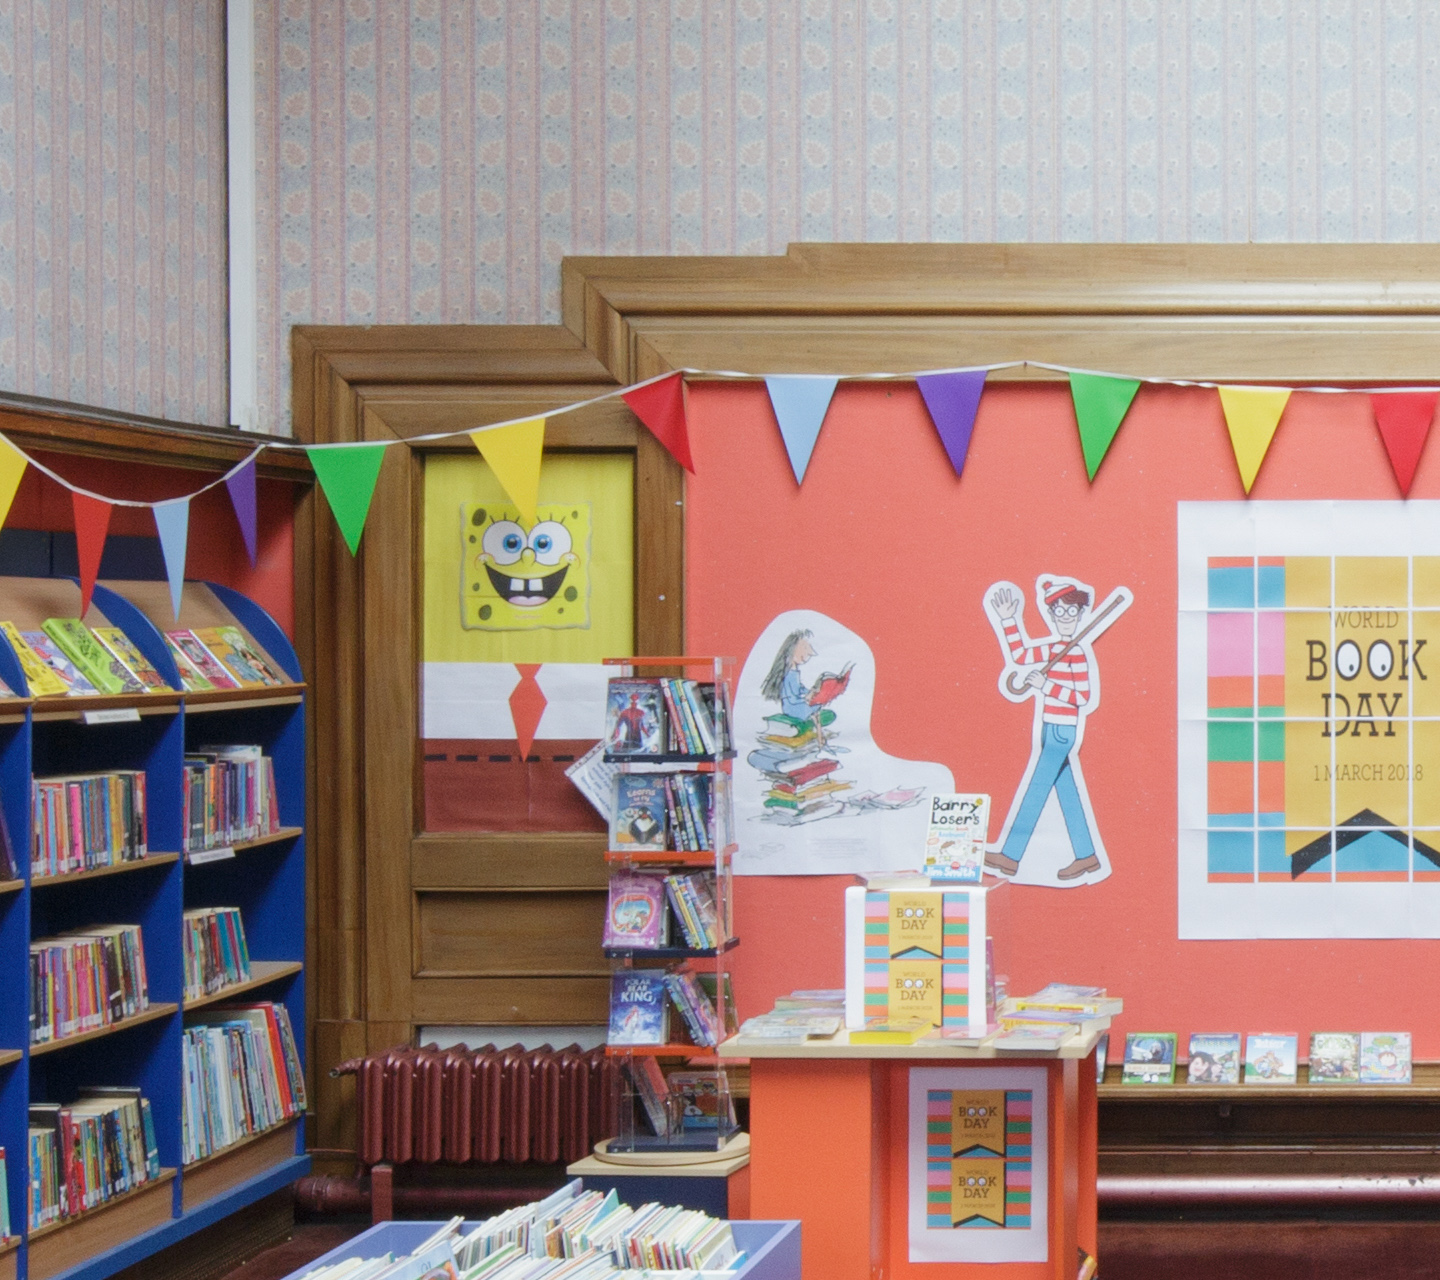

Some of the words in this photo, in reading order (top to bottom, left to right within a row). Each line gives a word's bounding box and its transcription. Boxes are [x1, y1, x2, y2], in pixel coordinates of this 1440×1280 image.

[1328, 605, 1399, 629] WORLD
[1306, 639, 1427, 682] BOOK
[1321, 693, 1402, 737] DAY
[1324, 765, 1383, 782] MARCH
[1388, 765, 1423, 781] 2018
[932, 797, 978, 813] Barry
[931, 813, 979, 825] Loser's
[942, 866, 975, 877] Smith
[897, 908, 934, 918] BOOK
[902, 920, 927, 930] DAY
[896, 979, 934, 988] BOOK
[621, 991, 652, 1003] KING
[901, 991, 926, 1000] DAY
[959, 1106, 997, 1117] BOOK
[964, 1118, 989, 1129] DAY
[959, 1176, 996, 1187] BOOK
[963, 1188, 990, 1199] DAY
